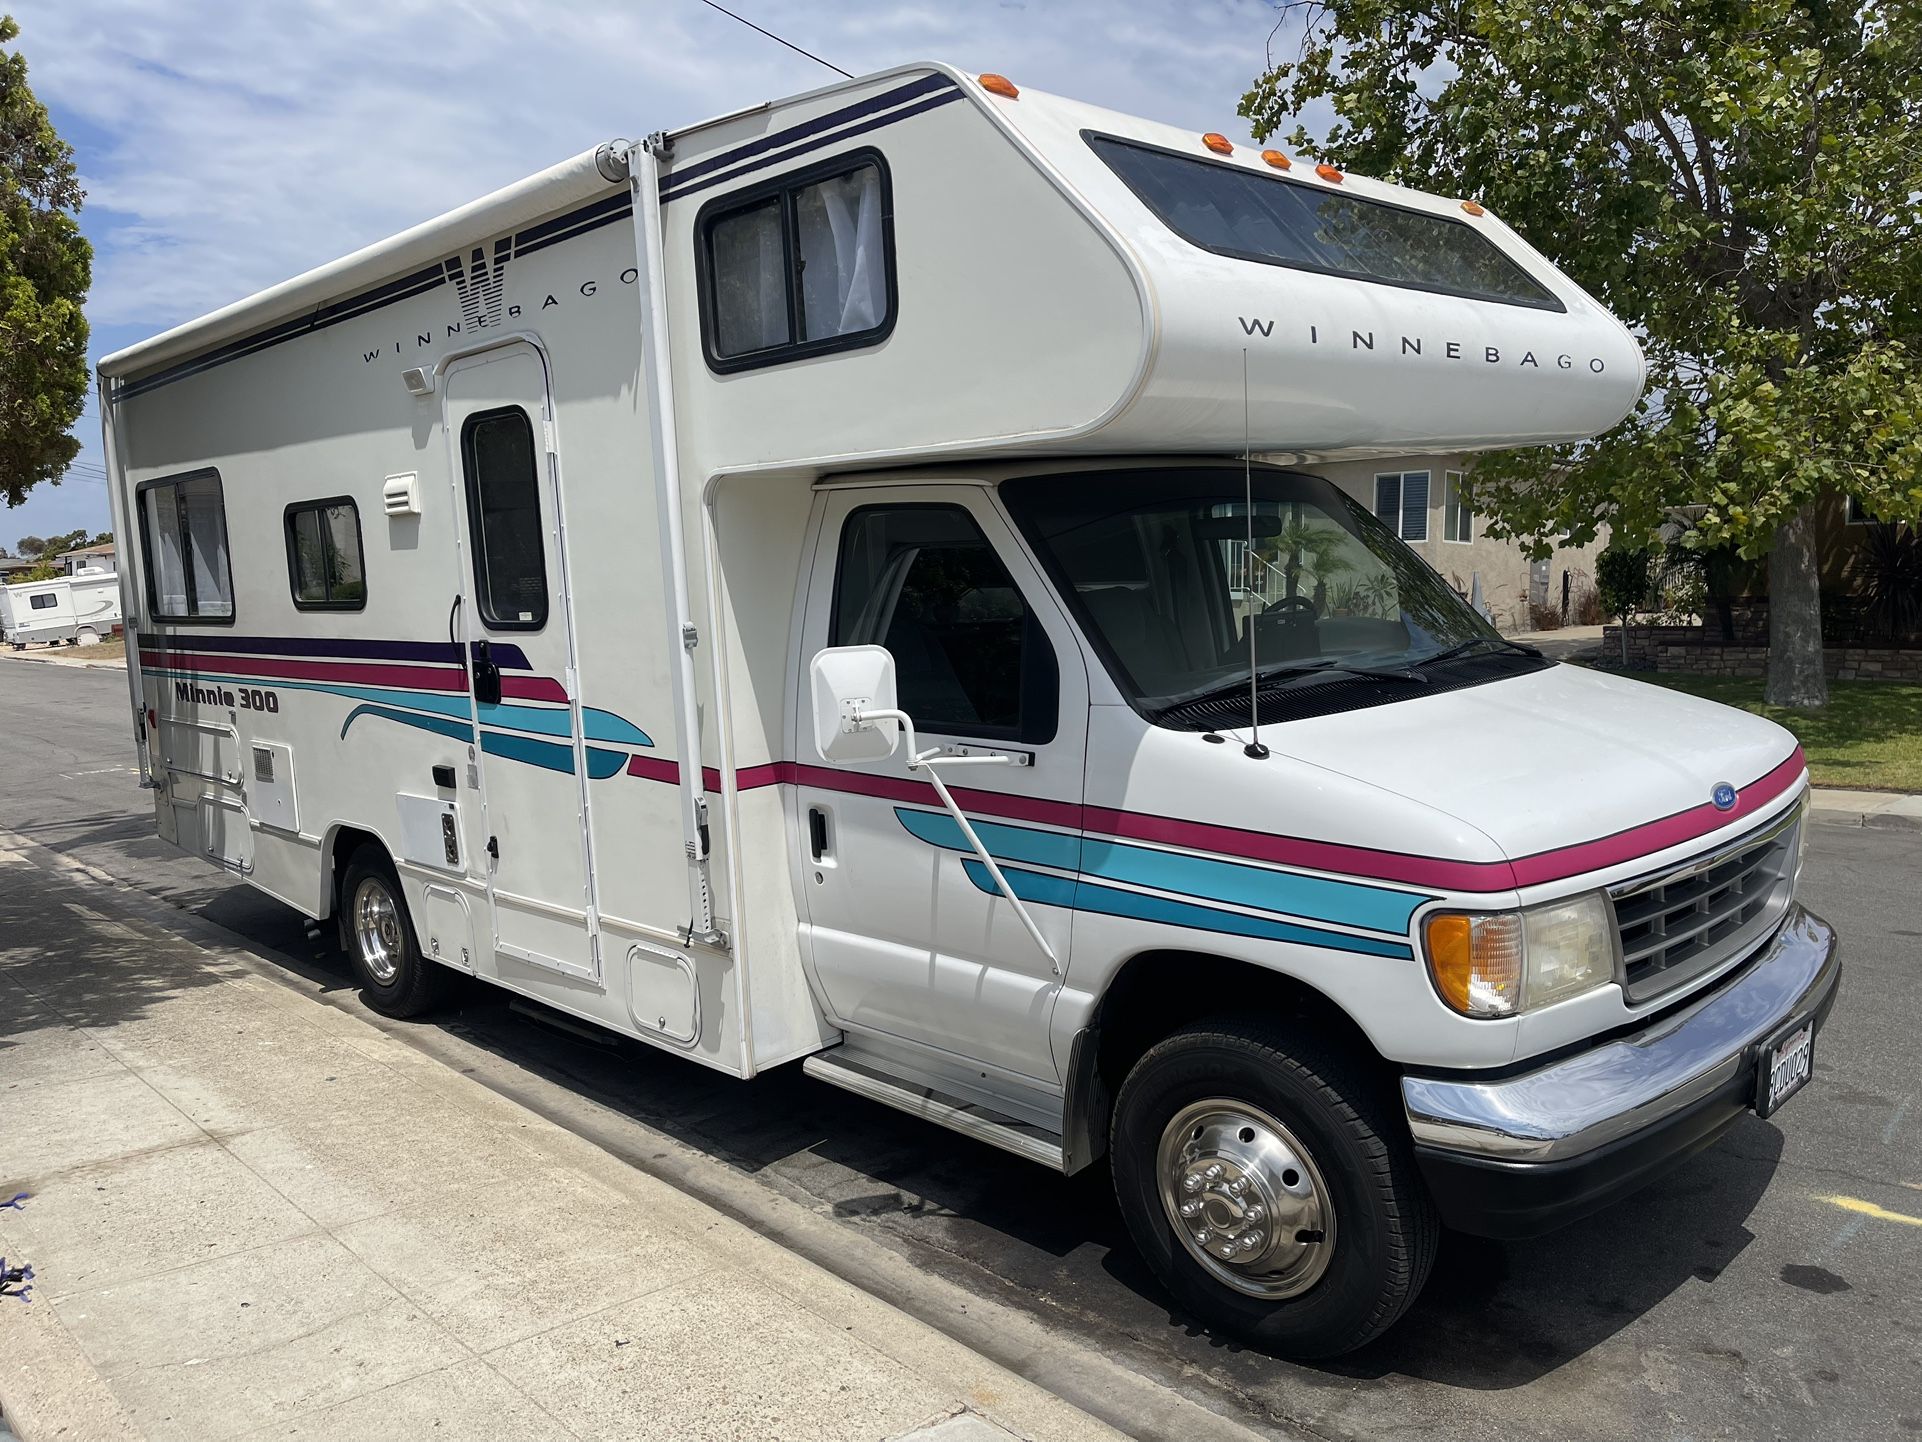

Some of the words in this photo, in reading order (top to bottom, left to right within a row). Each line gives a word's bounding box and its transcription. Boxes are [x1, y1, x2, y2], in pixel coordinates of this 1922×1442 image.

[363, 268, 639, 362] WINNEBAGO
[1238, 316, 1605, 374] WINNEBAGO
[175, 682, 235, 707] Minnie
[238, 687, 279, 714] 300
